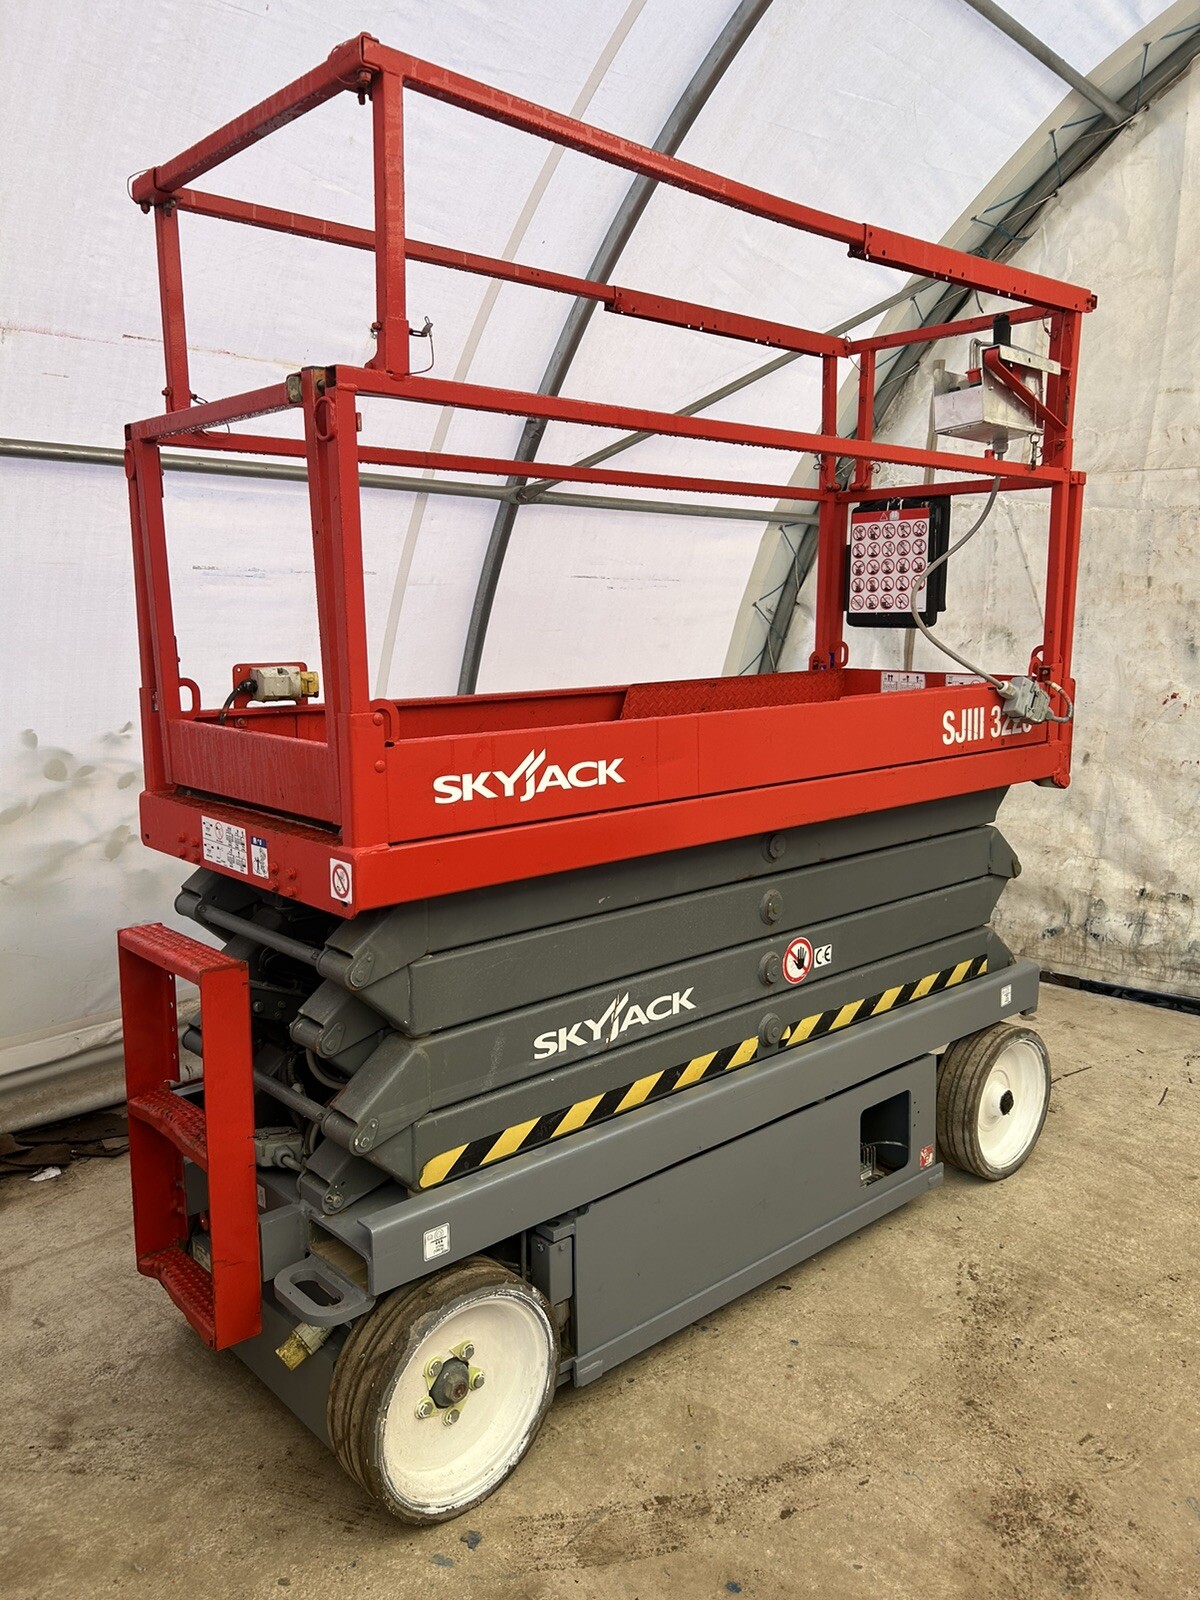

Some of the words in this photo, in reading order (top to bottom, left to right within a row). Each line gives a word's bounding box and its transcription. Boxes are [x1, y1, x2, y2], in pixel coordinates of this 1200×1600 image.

[942, 706, 985, 745] SJIII
[433, 748, 626, 804] SKYJACK
[816, 945, 831, 965] CE
[533, 987, 697, 1060] SKYJACK
